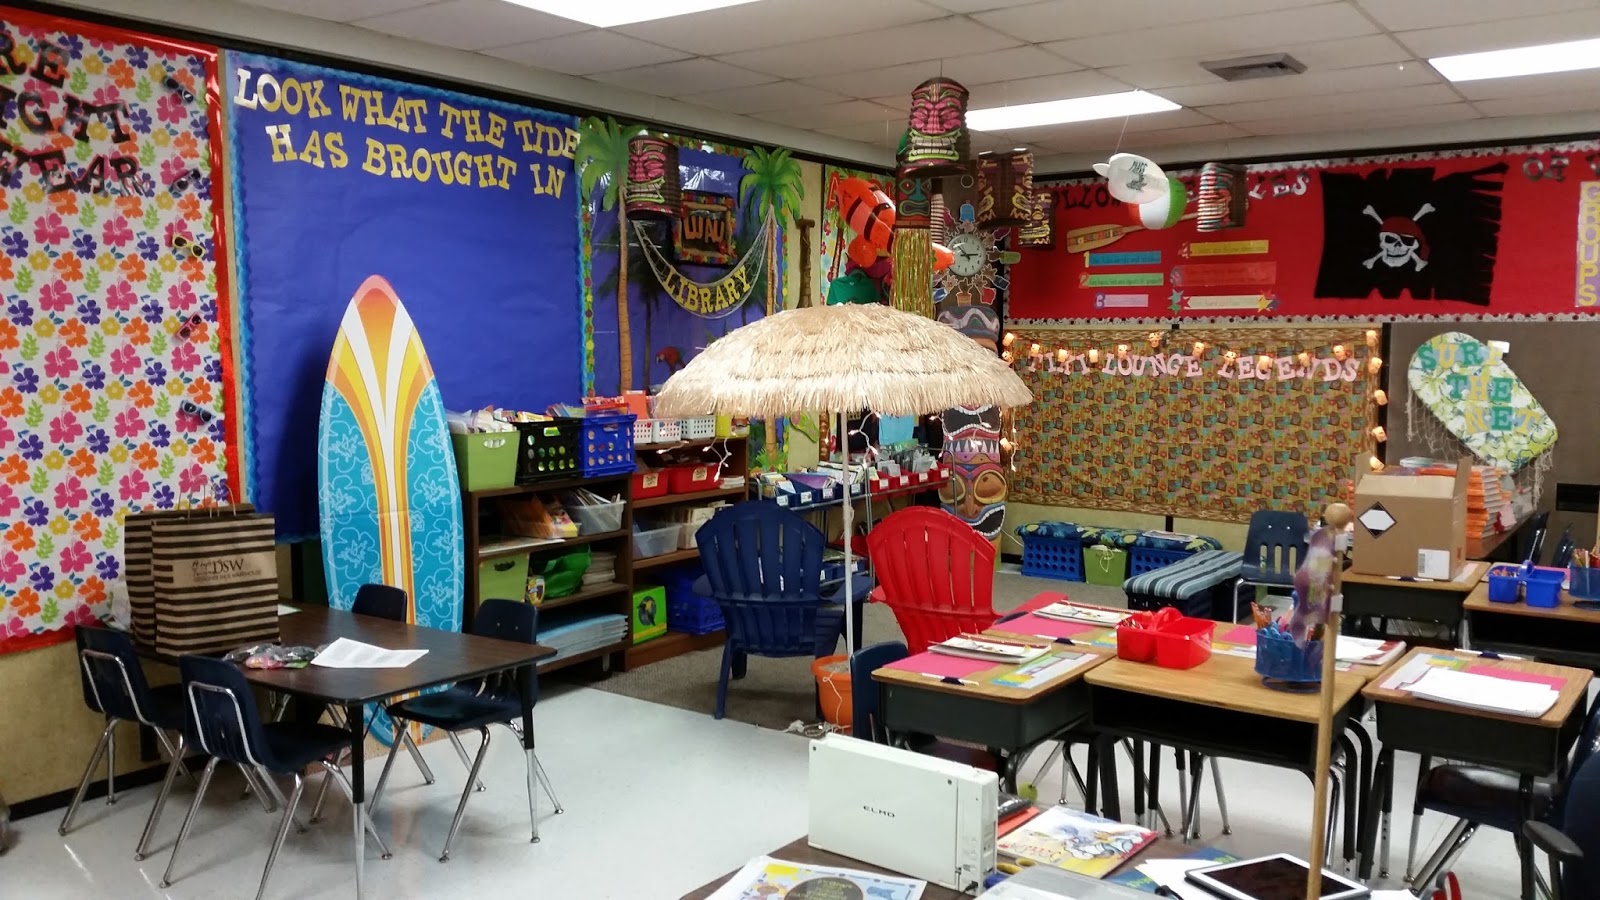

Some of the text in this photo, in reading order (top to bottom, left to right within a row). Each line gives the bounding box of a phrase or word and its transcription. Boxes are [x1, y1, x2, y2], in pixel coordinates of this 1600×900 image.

[233, 68, 581, 161] LOOK WHAT THE TIDE
[265, 124, 565, 198] HAS BROUGHT IN
[1578, 182, 1600, 307] GROUPS
[664, 265, 751, 314] LIBRARY
[1102, 352, 1204, 378] LOUNGE
[1217, 355, 1360, 382] LEGENDS
[1417, 341, 1504, 371] SURF
[1447, 368, 1514, 404] THE
[1465, 405, 1541, 435] NET
[212, 558, 244, 575] DSW
[863, 805, 895, 818] ELMO
